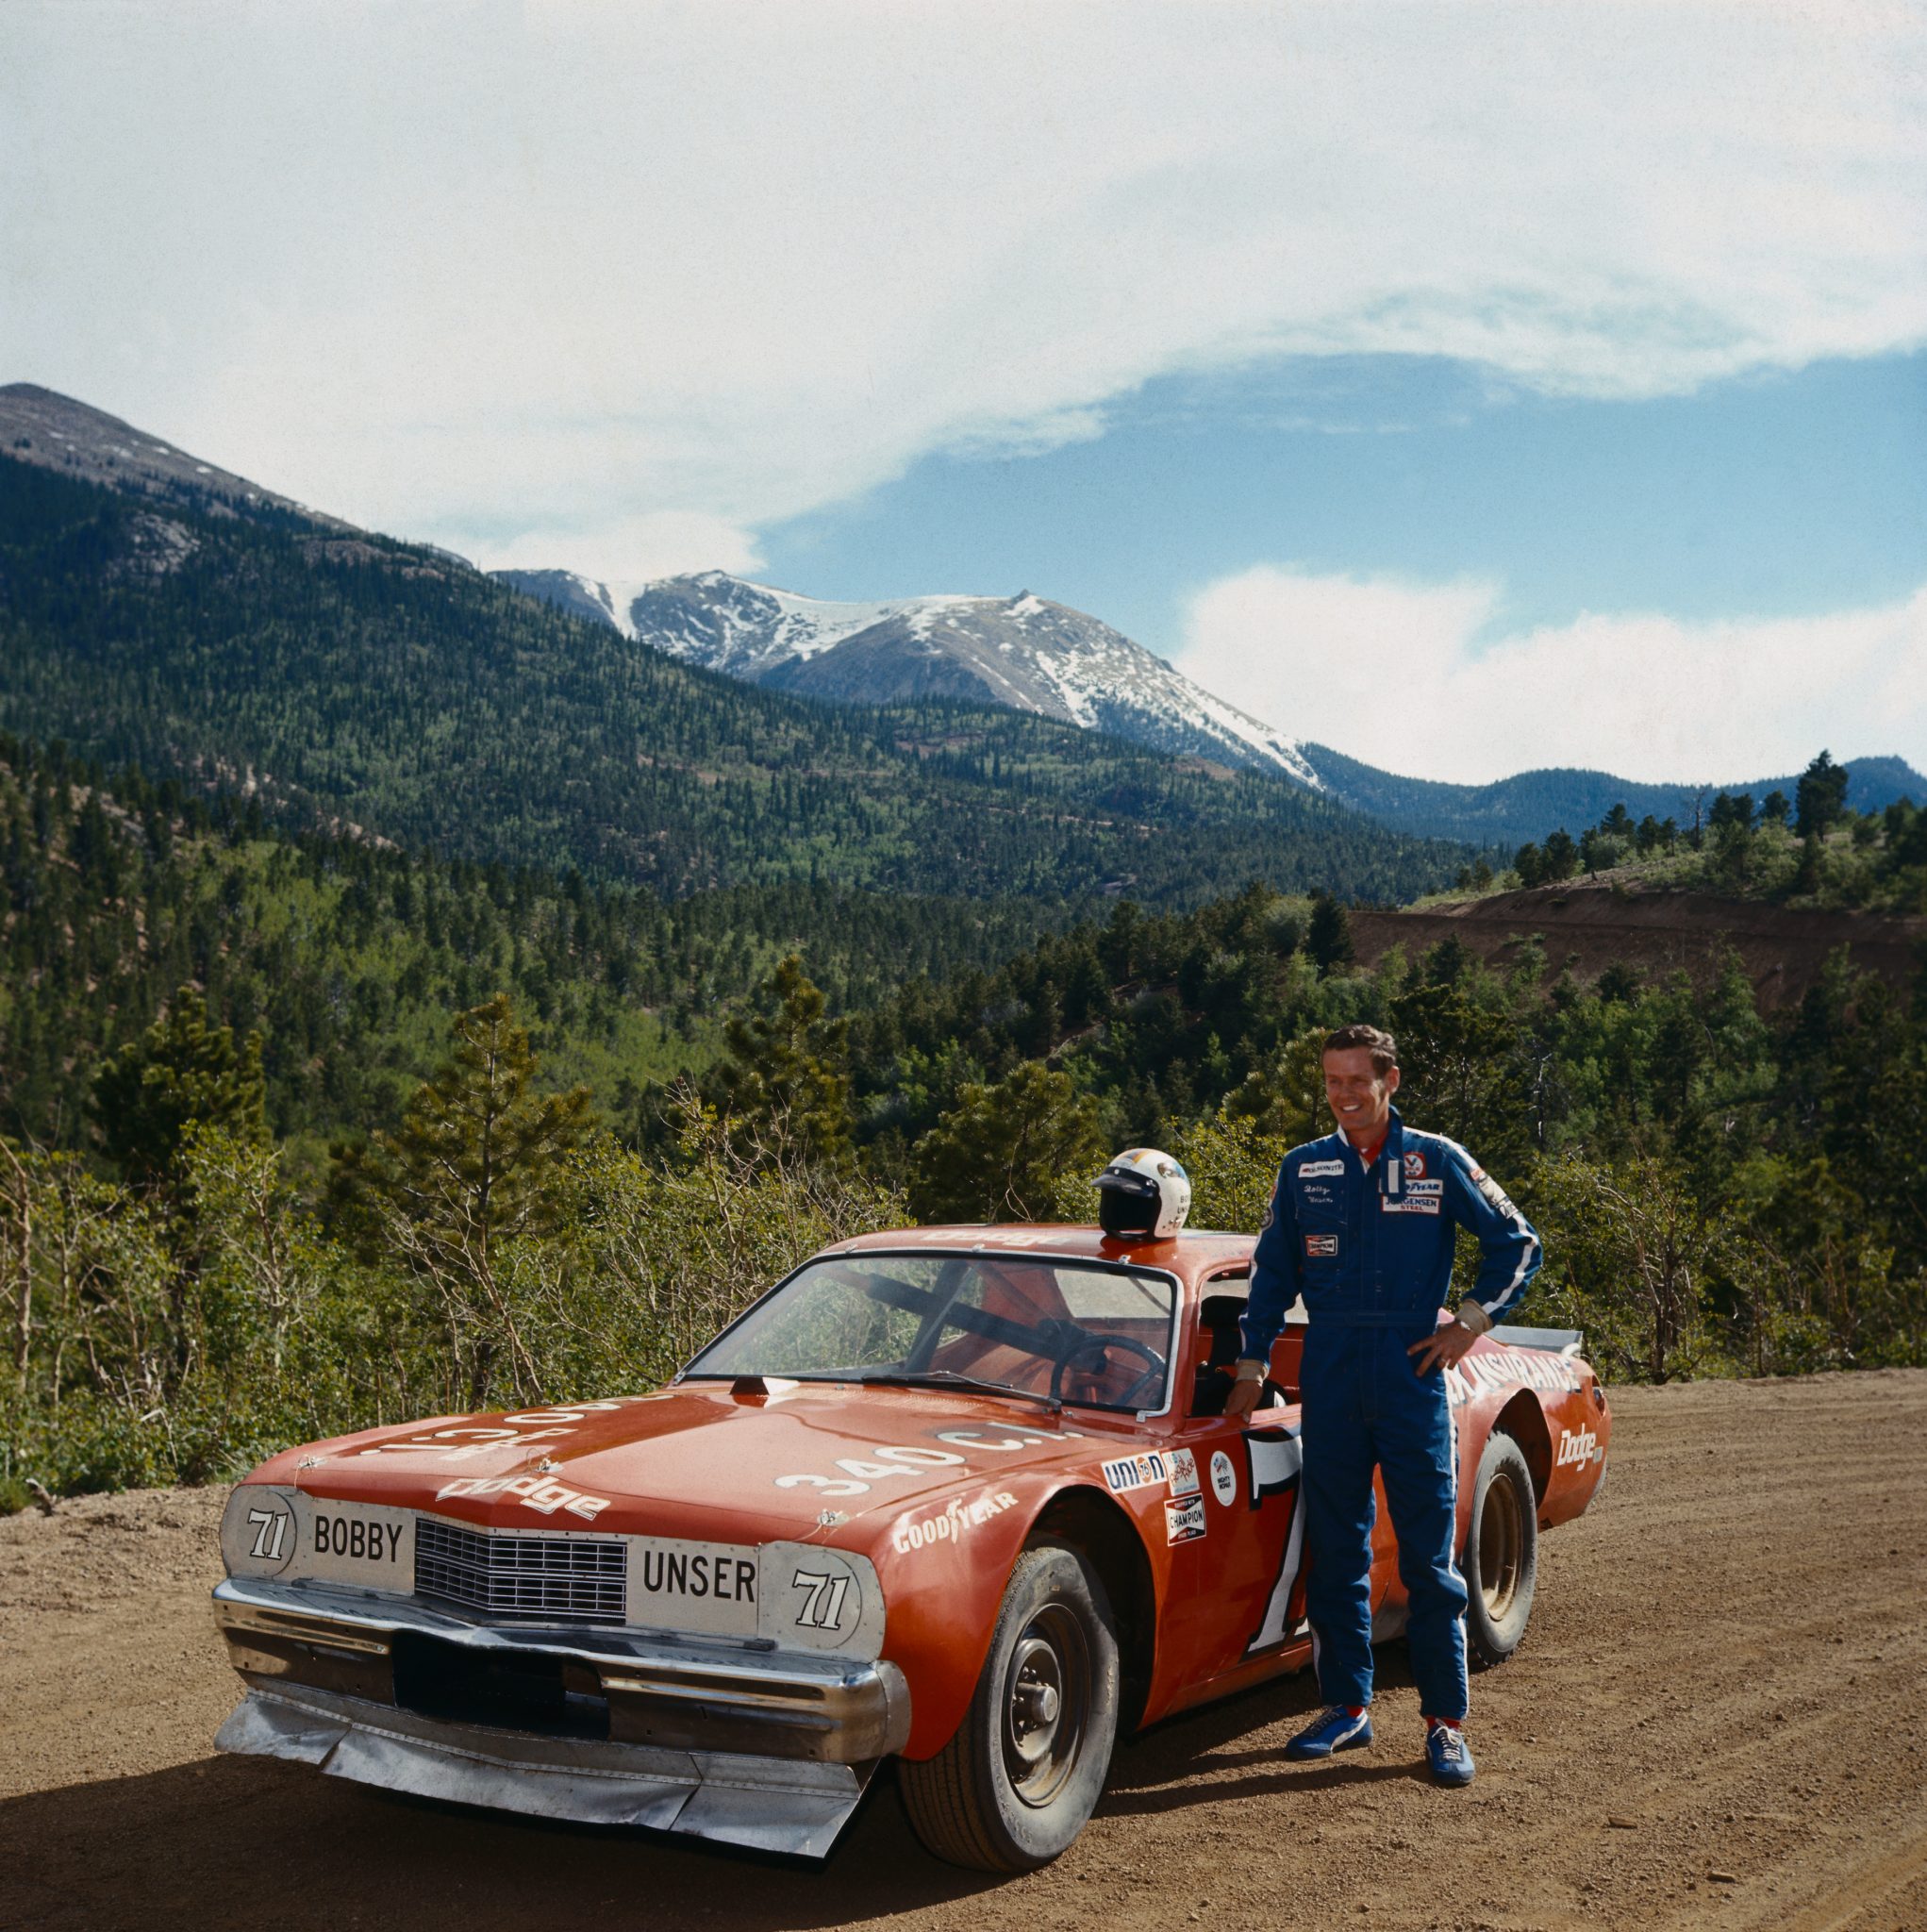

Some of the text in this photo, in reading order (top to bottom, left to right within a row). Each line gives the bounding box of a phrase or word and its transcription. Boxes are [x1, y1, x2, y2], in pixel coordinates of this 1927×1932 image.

[1462, 1352, 1582, 1394] INSURANCE
[773, 1446, 967, 1496] 340
[1139, 1462, 1151, 1477] 76
[1556, 1423, 1597, 1472] Dodge
[247, 1508, 290, 1561] 71
[314, 1515, 404, 1563] BOBBY
[892, 1491, 1019, 1555] GOODYEAR
[1170, 1509, 1204, 1529] CHAMPION
[643, 1550, 756, 1603] UNSER
[792, 1569, 851, 1630] 71
